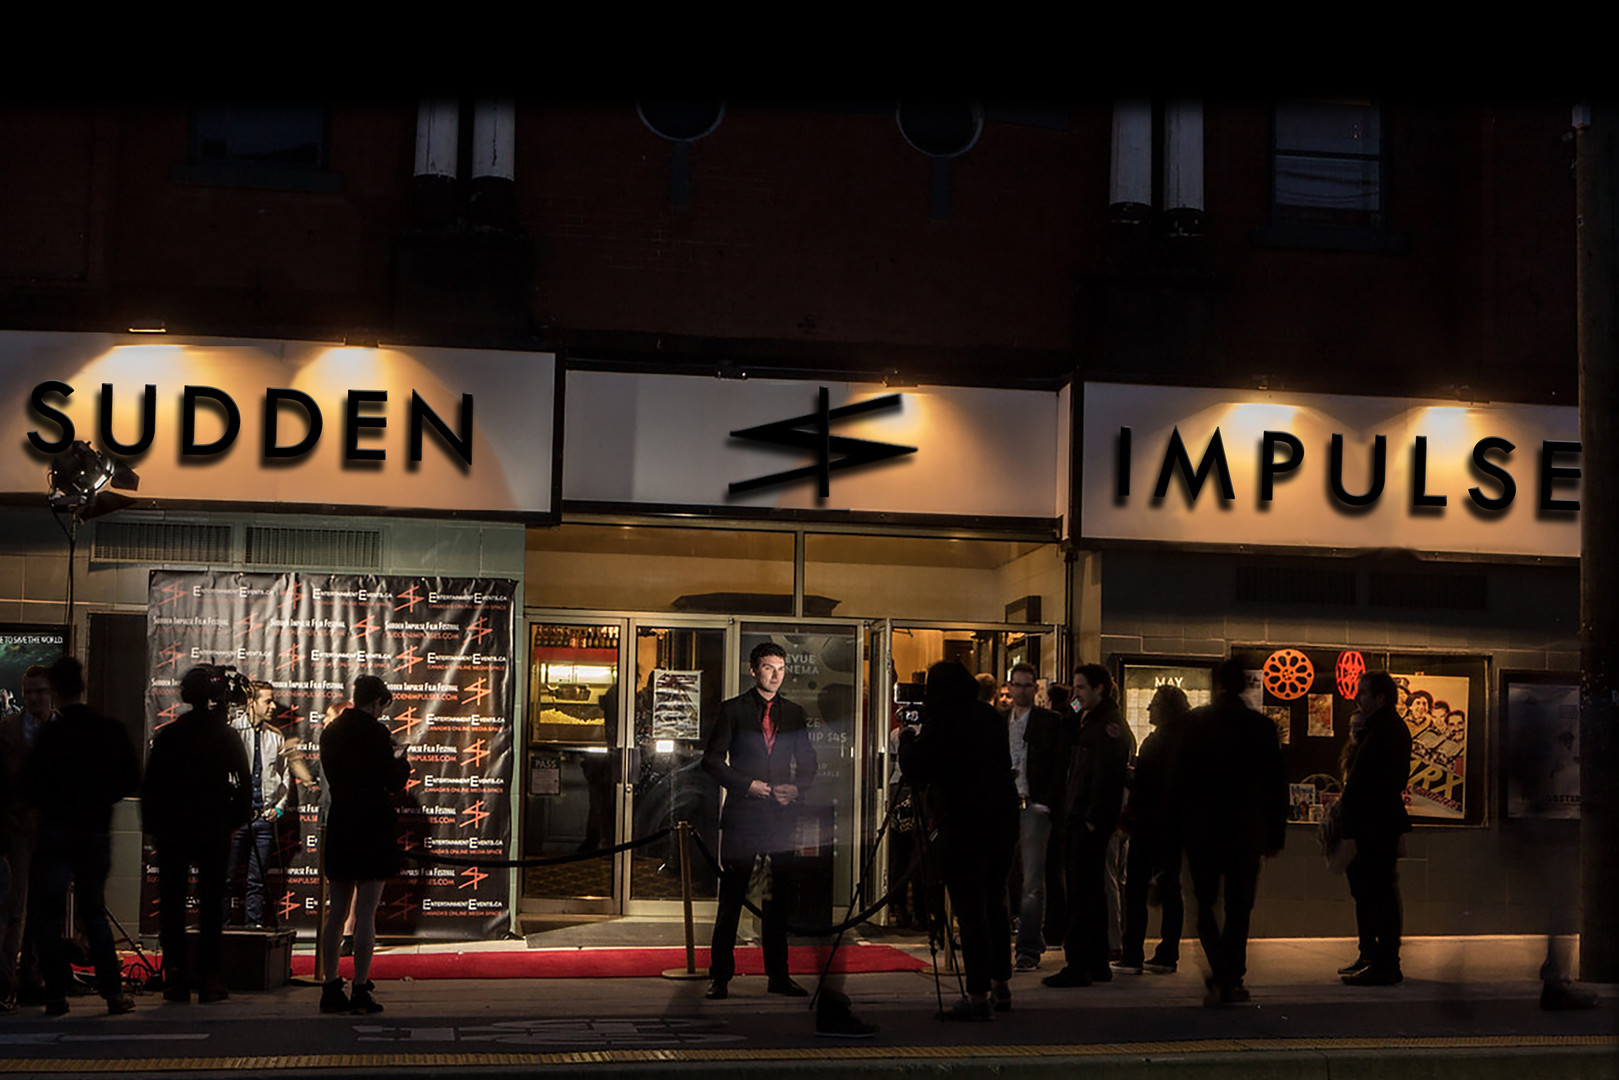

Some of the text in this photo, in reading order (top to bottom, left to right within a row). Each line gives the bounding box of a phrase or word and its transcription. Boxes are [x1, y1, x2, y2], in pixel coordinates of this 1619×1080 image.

[26, 380, 474, 466] SUDDEN
[1112, 425, 1582, 511] IMPULSE
[27, 635, 40, 644] THE
[785, 654, 816, 664] EVUE
[1154, 676, 1184, 687] MAY
